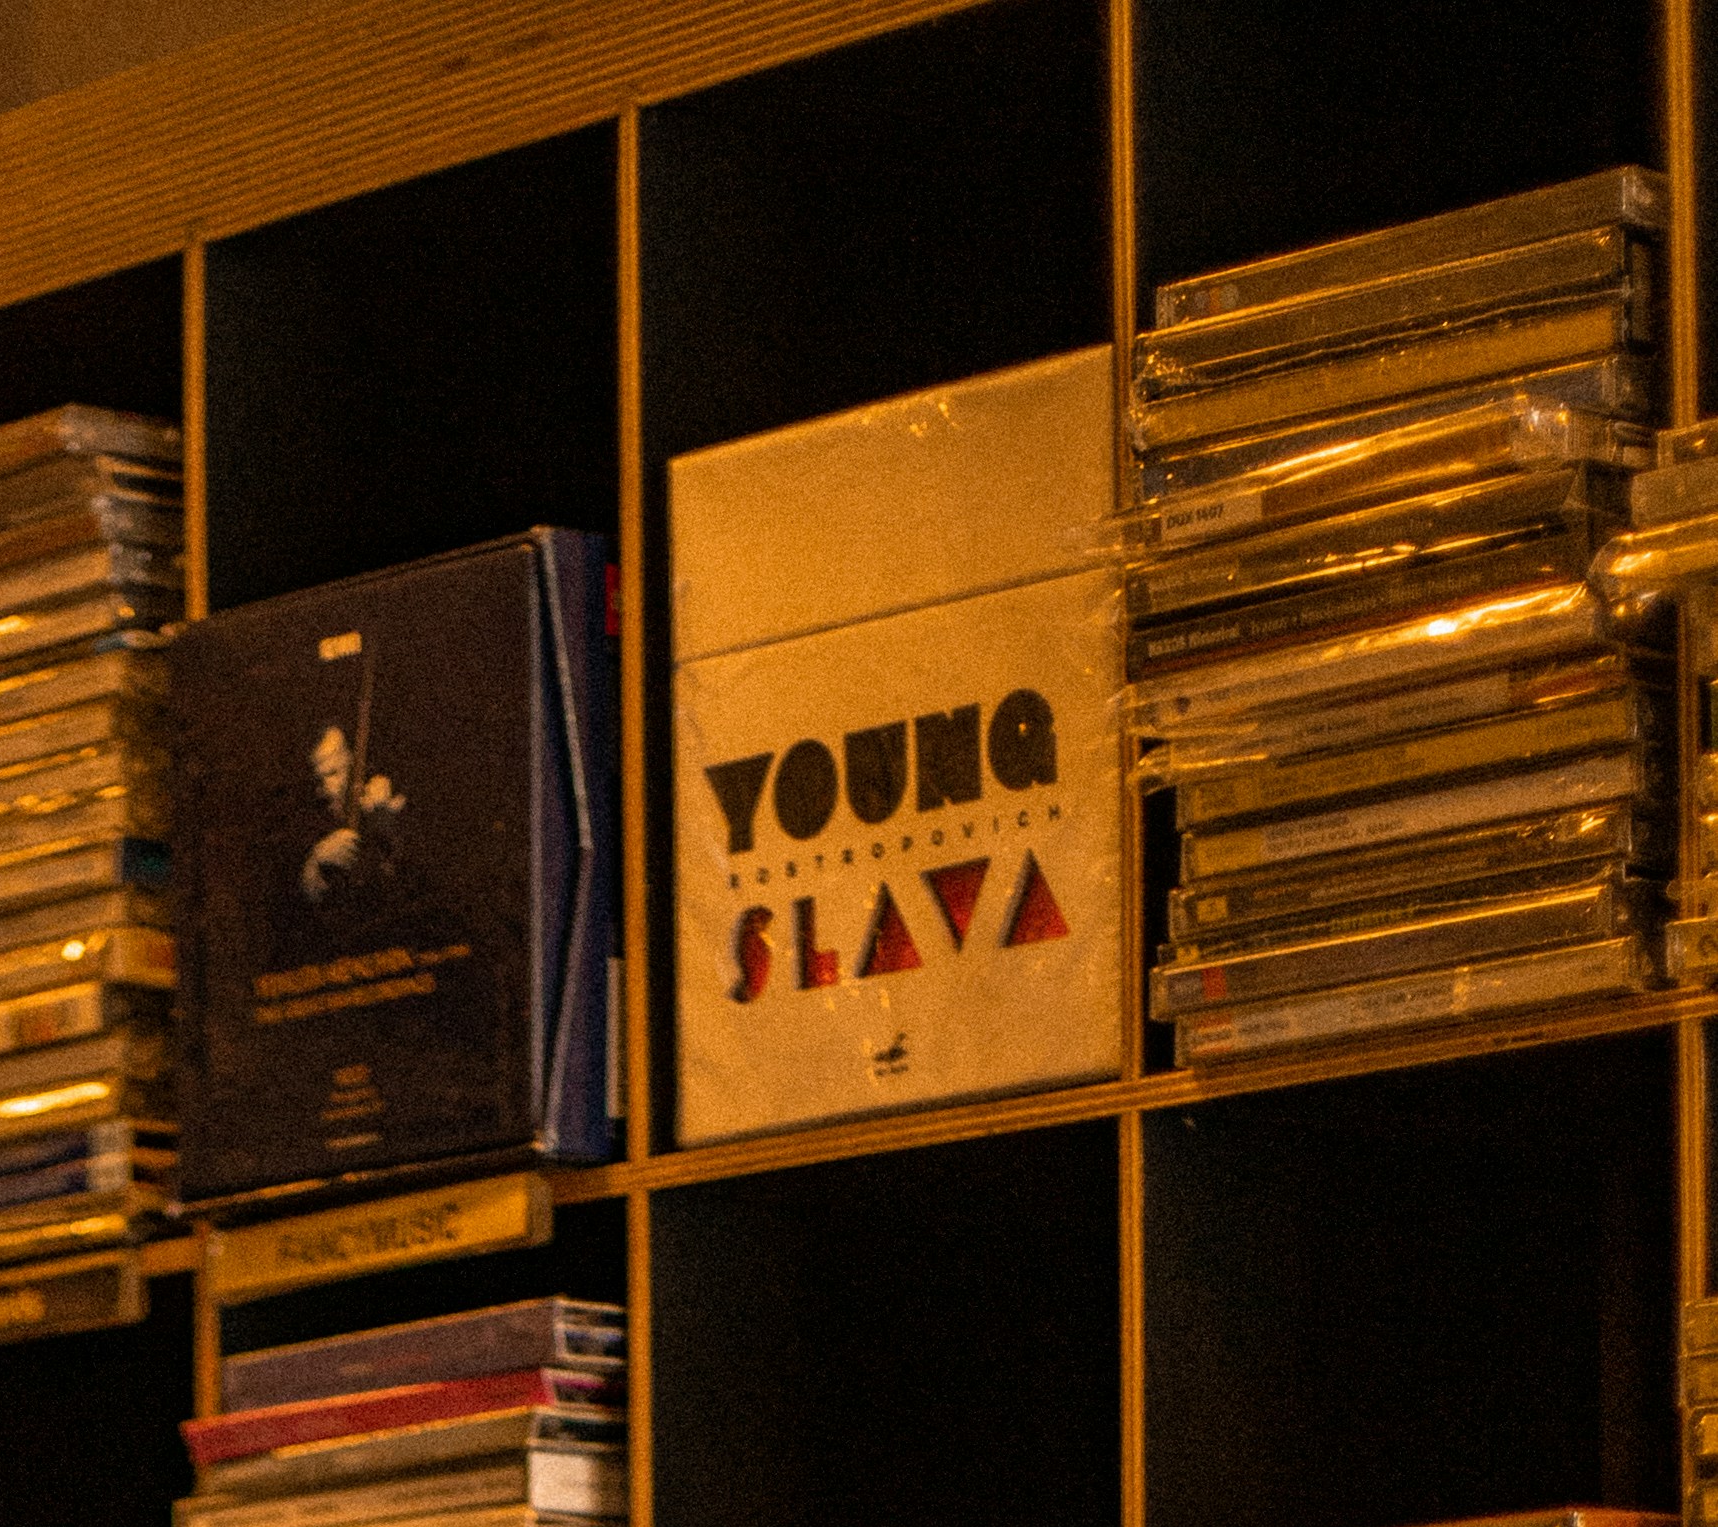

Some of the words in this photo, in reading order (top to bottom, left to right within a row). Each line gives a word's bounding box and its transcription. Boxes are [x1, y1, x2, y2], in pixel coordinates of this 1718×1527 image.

[704, 687, 1058, 853] YOUNG
[728, 806, 1063, 889] ROSTROPOVICH
[730, 848, 1070, 1004] SLAVA
